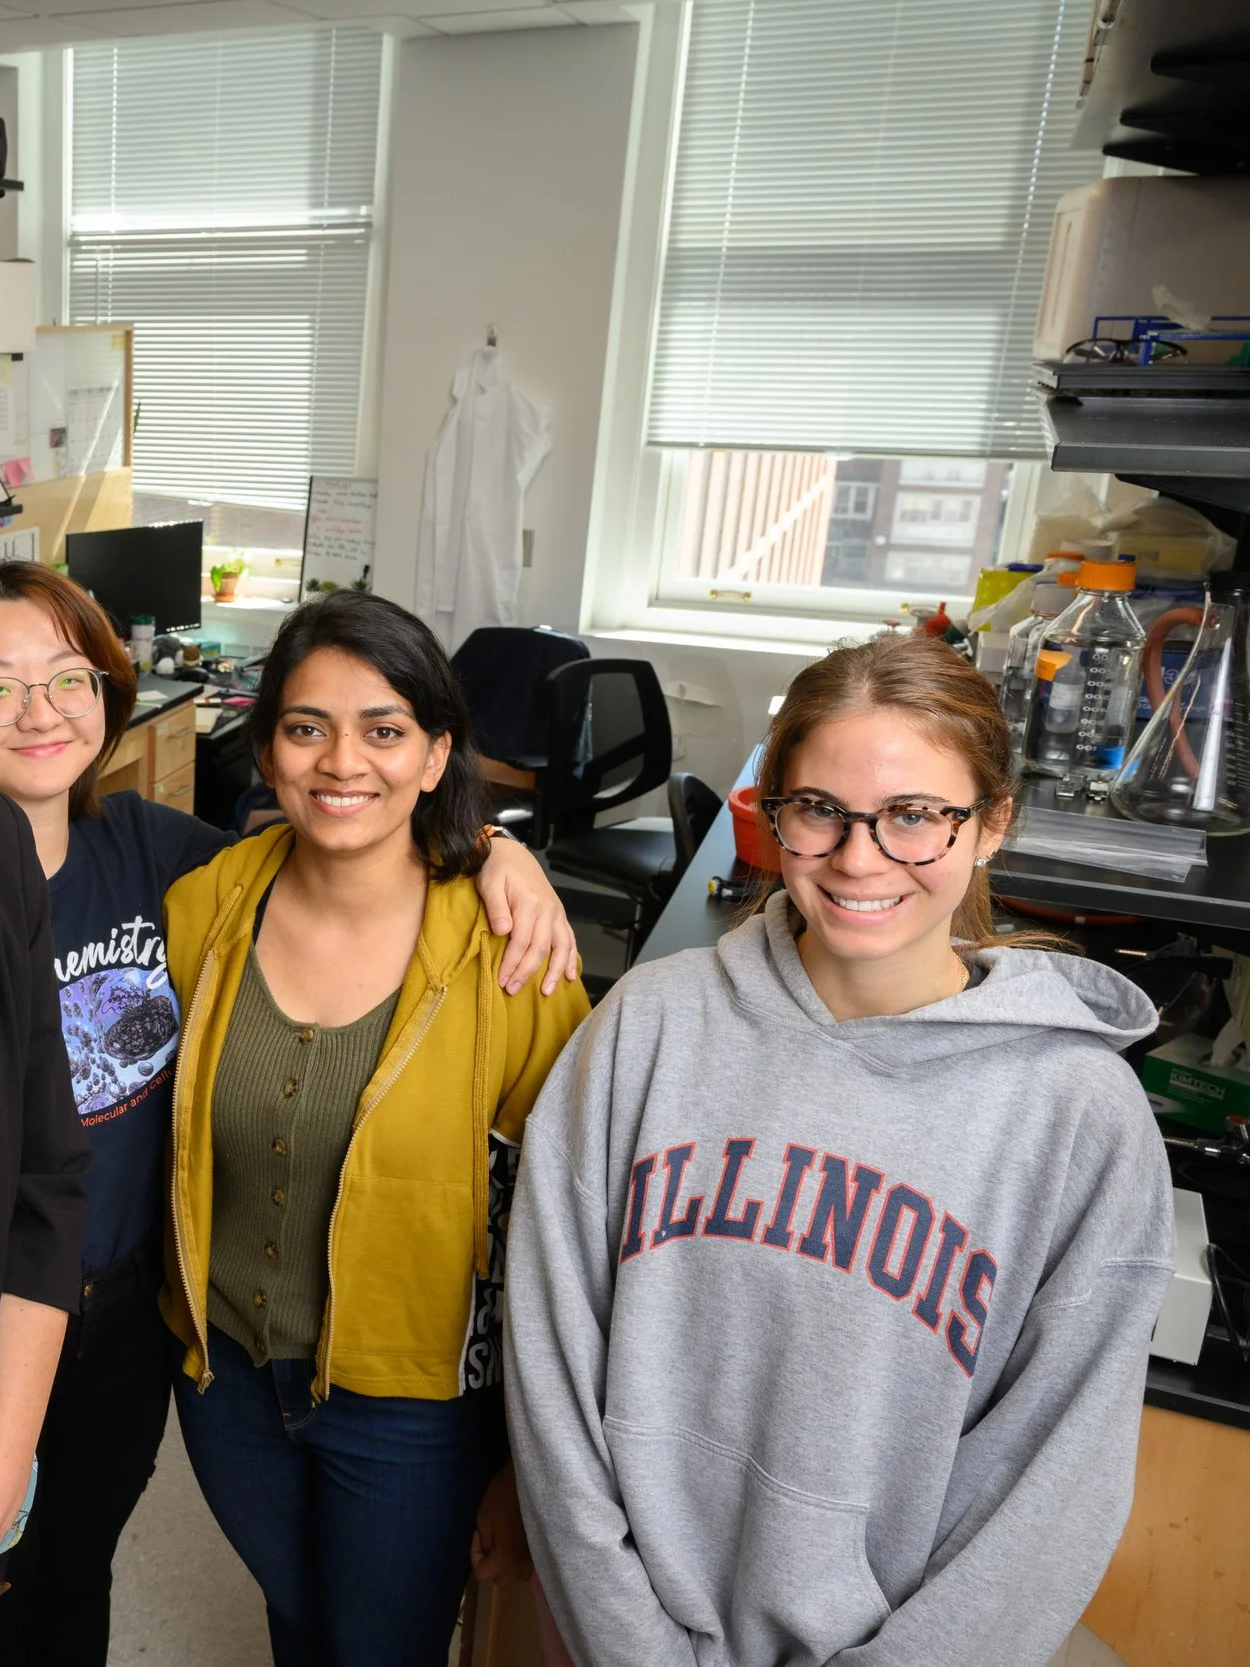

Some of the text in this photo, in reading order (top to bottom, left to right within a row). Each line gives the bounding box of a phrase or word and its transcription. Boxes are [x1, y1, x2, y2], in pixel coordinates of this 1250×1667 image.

[1170, 1071, 1226, 1096] KIMTECH
[81, 1103, 128, 1127] Molecular
[130, 1088, 148, 1107] and
[619, 1137, 999, 1379] ILLINOIS
